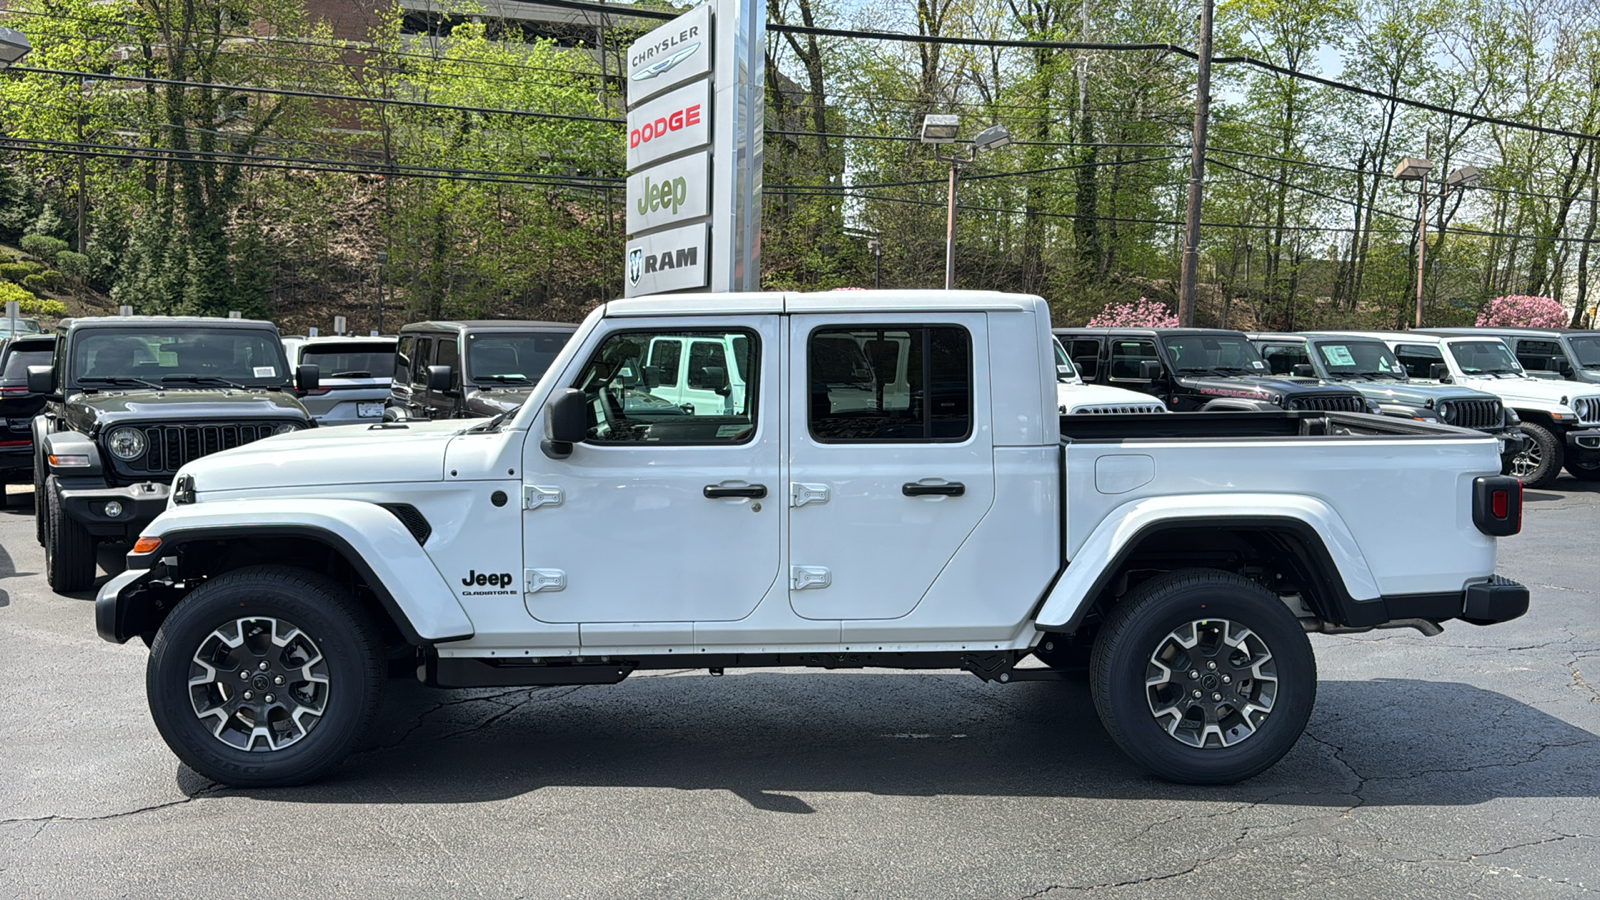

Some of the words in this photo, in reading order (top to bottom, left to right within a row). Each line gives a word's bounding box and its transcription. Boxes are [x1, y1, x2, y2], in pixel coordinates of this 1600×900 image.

[631, 25, 699, 68] CHRYSLER
[630, 104, 701, 149] DODGE
[637, 175, 687, 216] Jeep
[645, 246, 698, 274] RAM
[1200, 387, 1270, 400] RUBICON
[461, 569, 513, 589] Jeep
